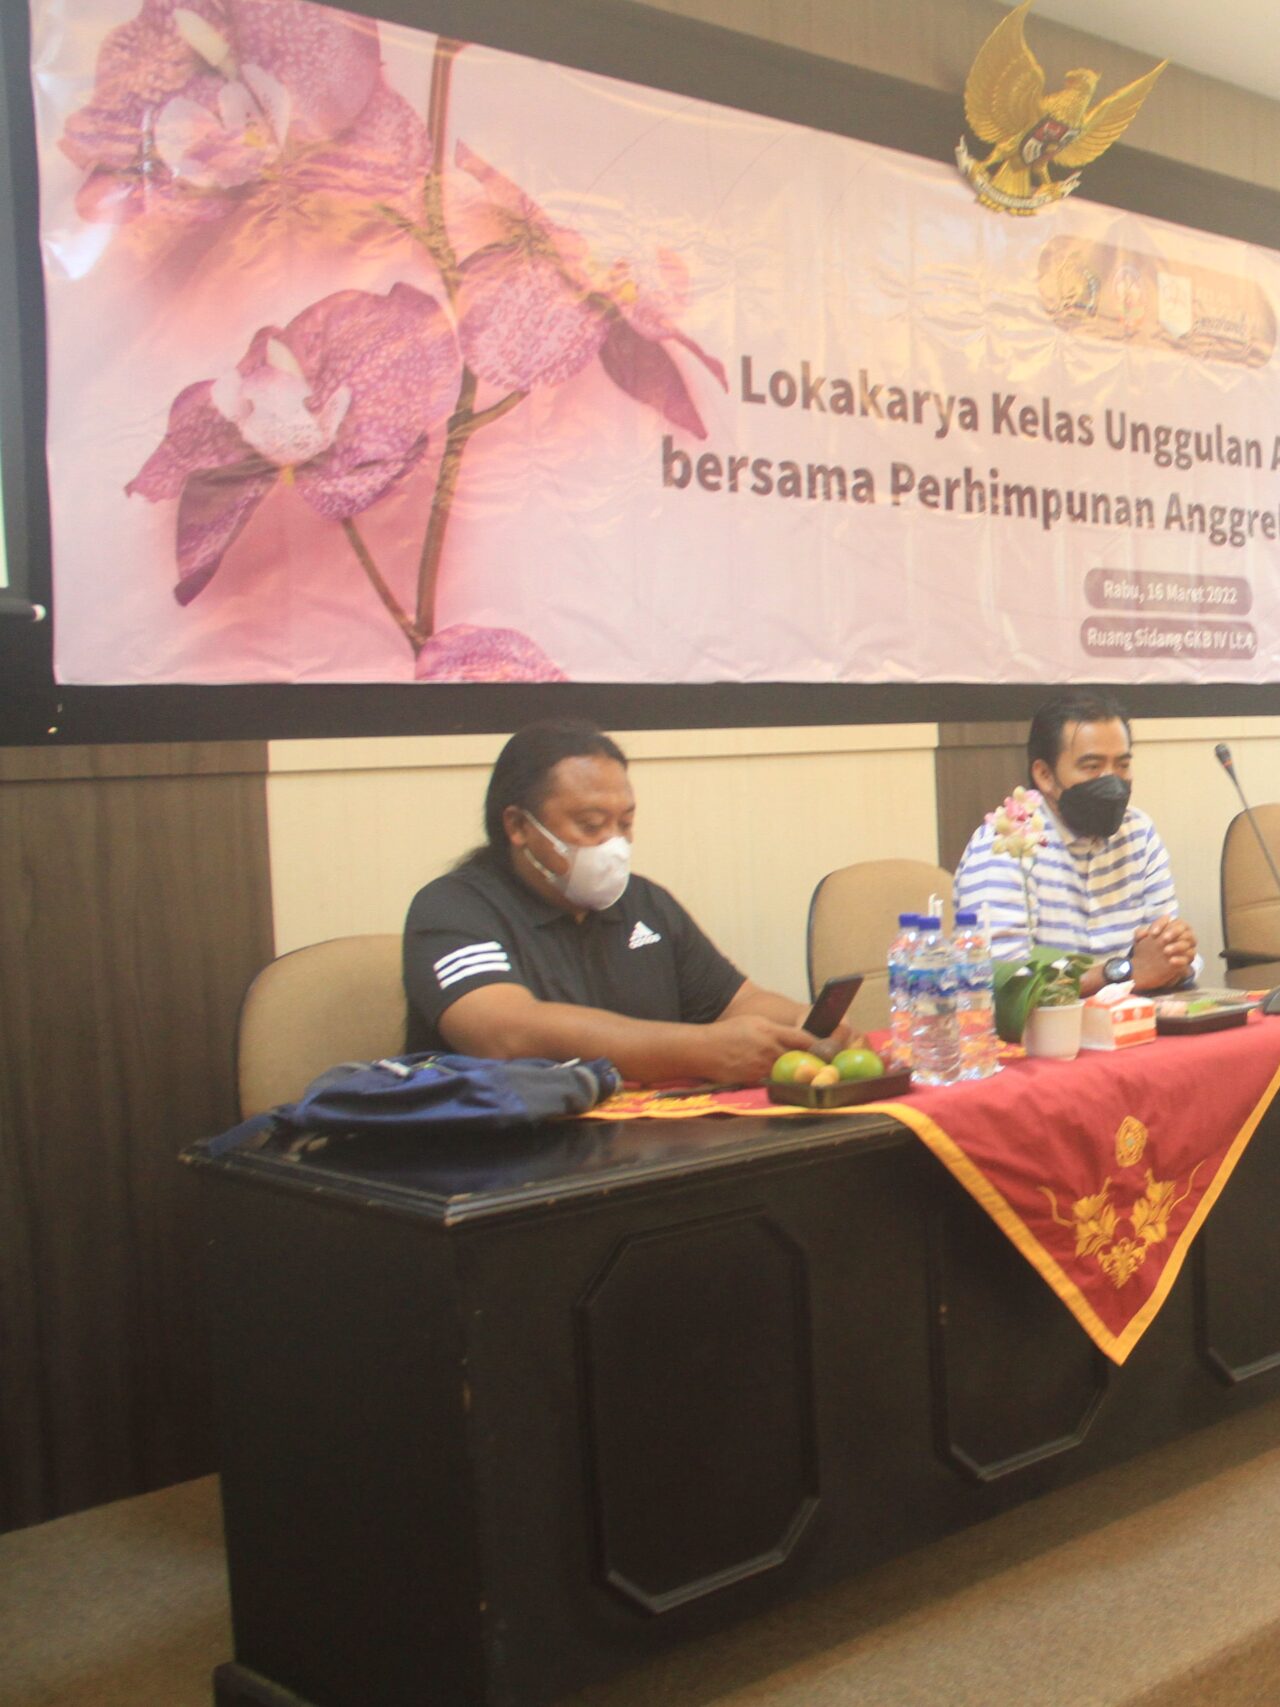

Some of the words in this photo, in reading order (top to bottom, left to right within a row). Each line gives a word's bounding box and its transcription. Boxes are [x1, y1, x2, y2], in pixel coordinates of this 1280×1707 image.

[741, 355, 979, 439] Lokakarya
[992, 391, 1095, 446] Kelas
[1105, 408, 1263, 470] Unggulan
[661, 434, 875, 504] bersama
[891, 462, 1155, 531] Perhimpunan
[1103, 579, 1144, 604] Rabu,
[1147, 582, 1163, 600] 16
[1166, 583, 1205, 602] Maret
[1206, 585, 1238, 605] 2022
[1087, 627, 1133, 652] Ruang
[1134, 627, 1183, 653] Sidang
